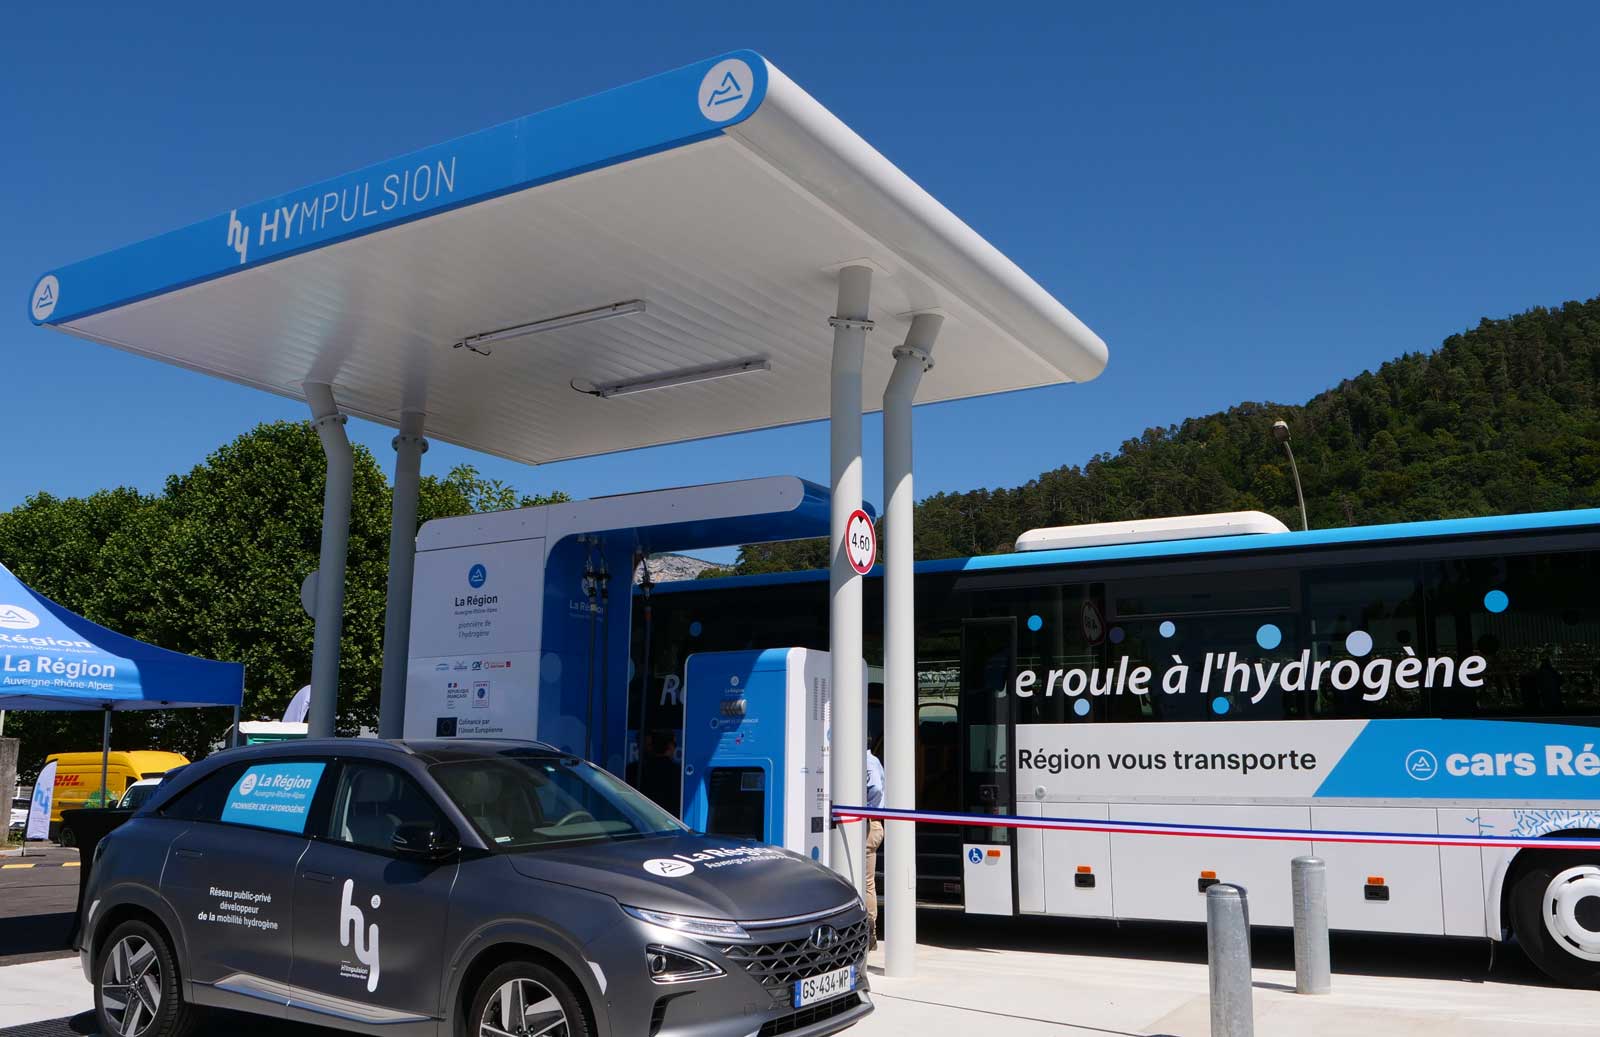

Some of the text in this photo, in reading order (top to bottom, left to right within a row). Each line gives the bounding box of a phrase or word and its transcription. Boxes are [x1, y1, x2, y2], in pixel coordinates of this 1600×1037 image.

[259, 156, 456, 246] HYMPULSION
[851, 533, 870, 551] 4.60
[455, 594, 498, 607] La Région
[4, 655, 116, 679] La Région
[1046, 655, 1152, 697] roule
[1162, 654, 1189, 694] à
[1200, 646, 1487, 704] l'hydrogène
[3, 677, 114, 691] Auvergne-Rhône-Alpes
[1018, 748, 1100, 774] Région
[1107, 753, 1167, 770] vous
[1173, 750, 1317, 776] transporte
[1445, 743, 1600, 777] cars Ré
[258, 774, 312, 791] La Région
[673, 850, 715, 862] La
[209, 887, 272, 903] Réseau public-privé
[220, 901, 260, 914] développeur
[198, 911, 279, 930] de la mobilité hydrogène
[803, 969, 849, 999] GS-434-WP
